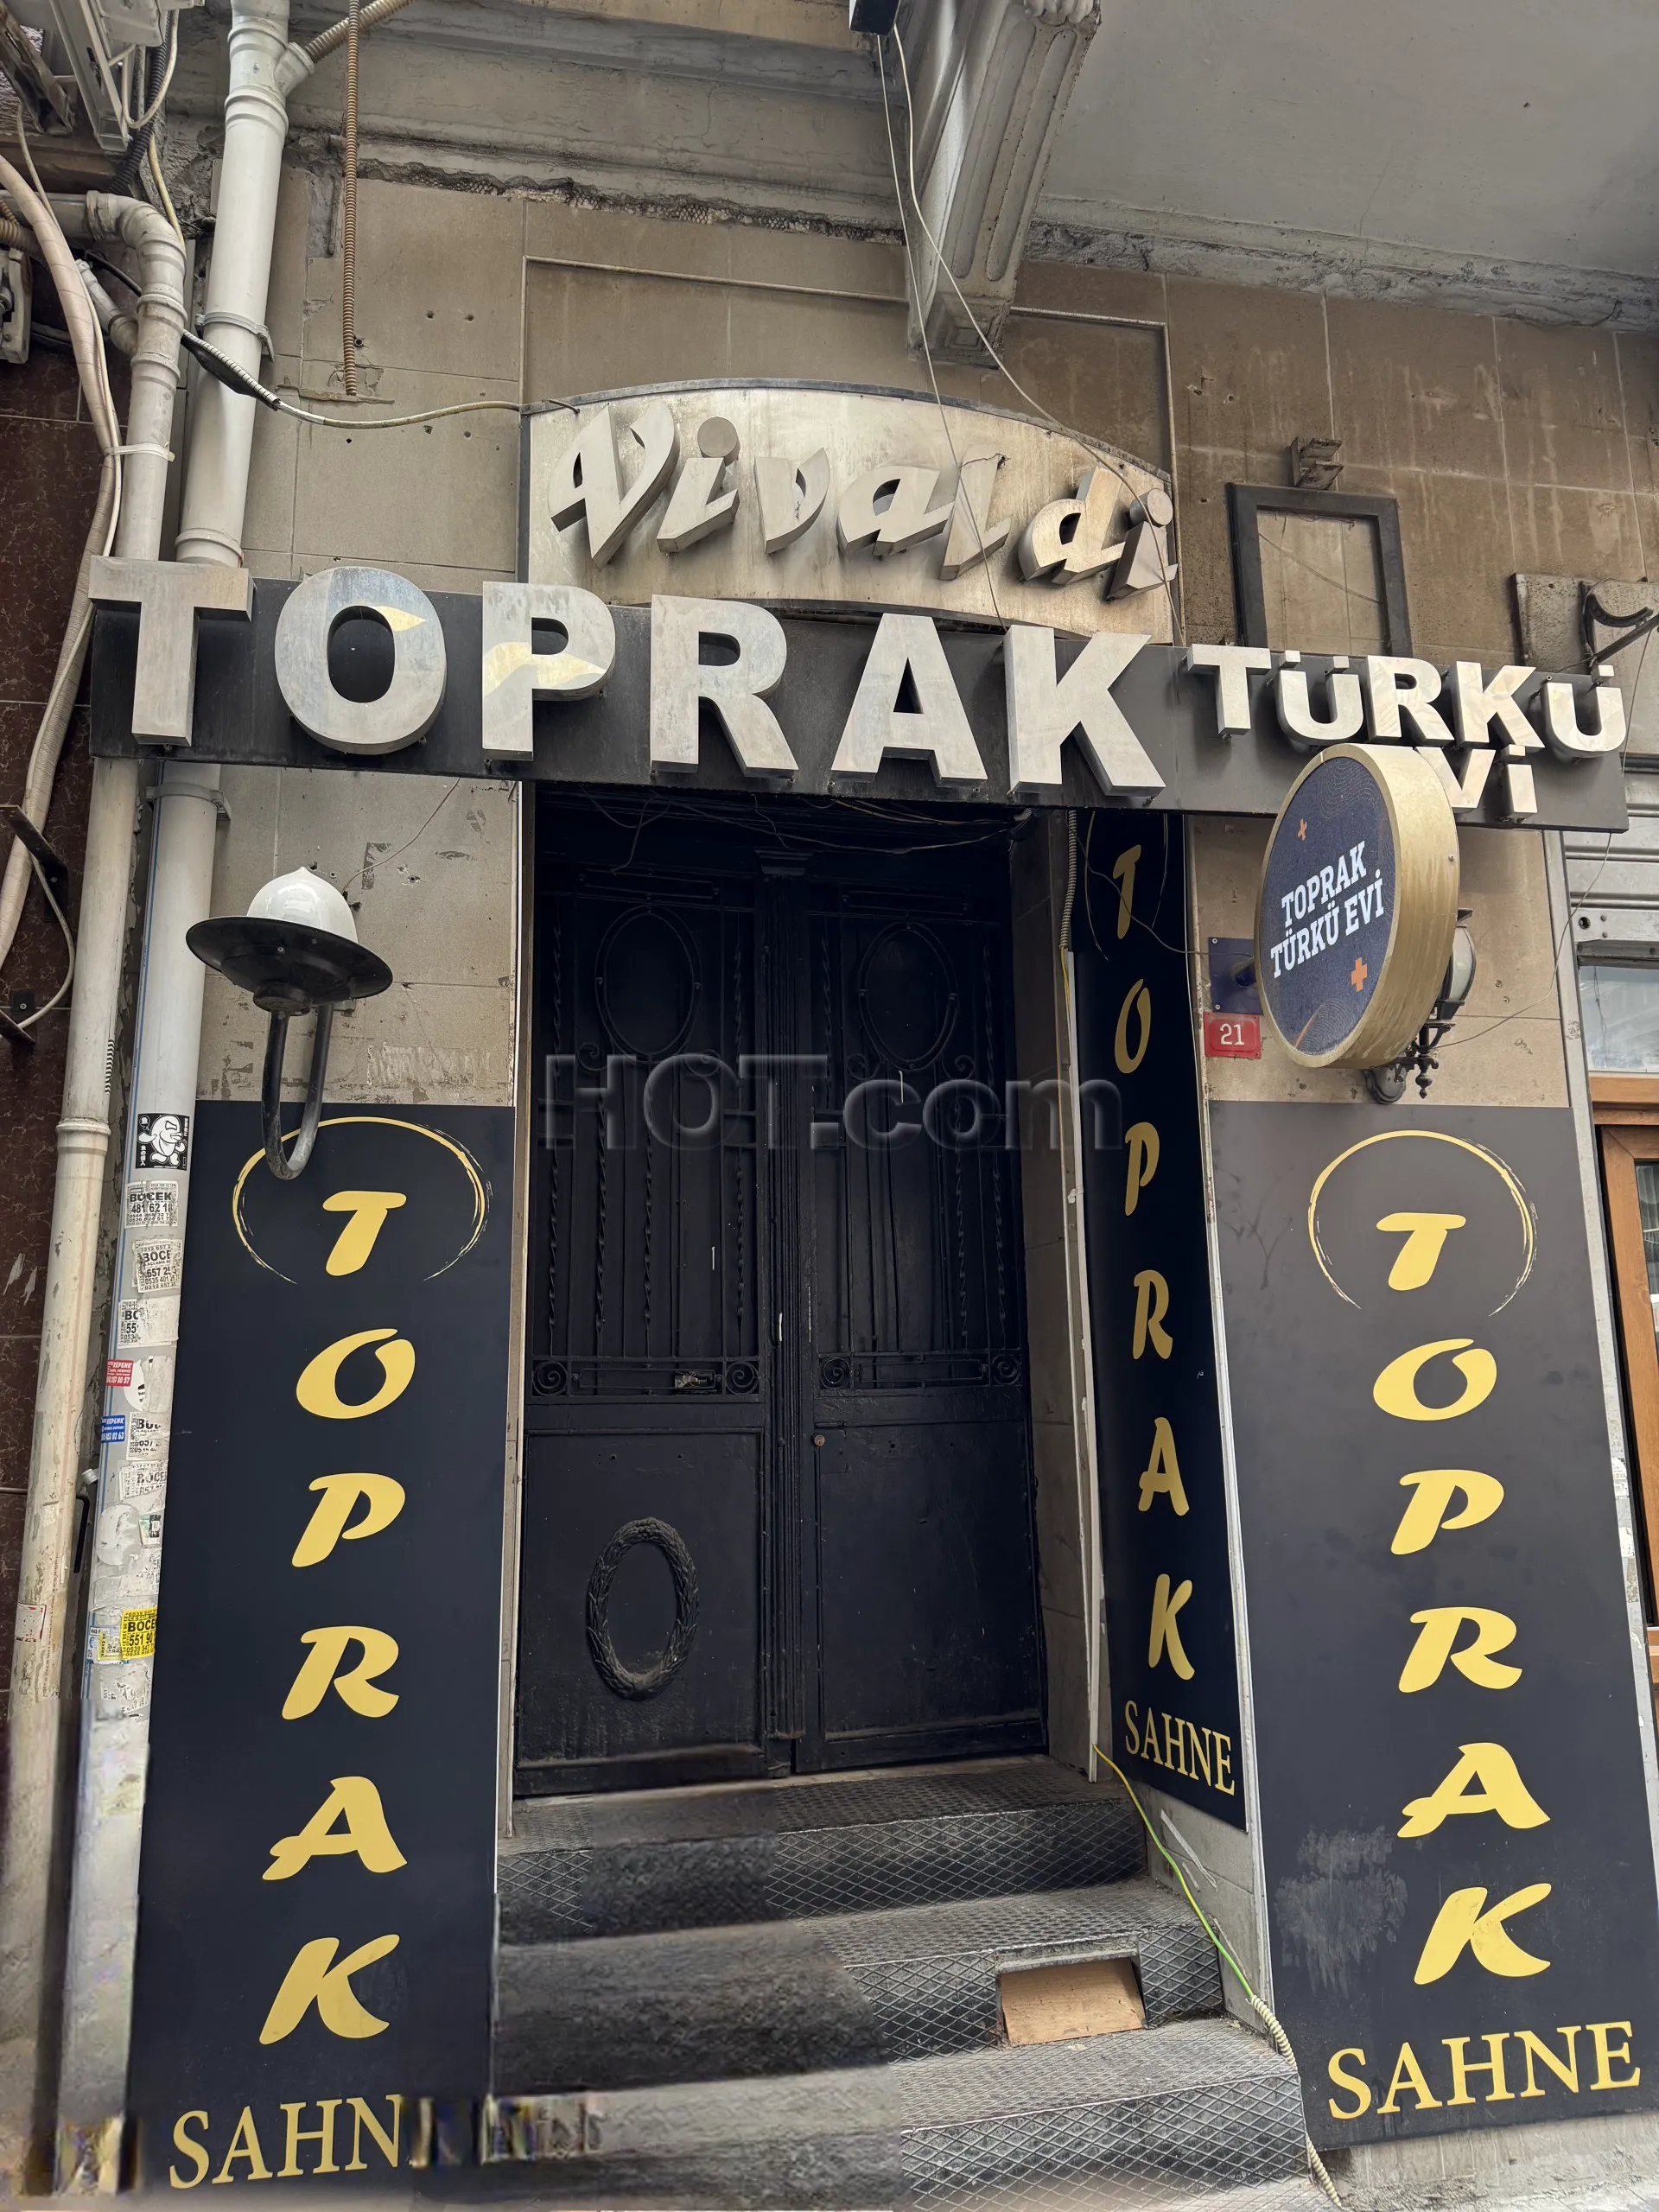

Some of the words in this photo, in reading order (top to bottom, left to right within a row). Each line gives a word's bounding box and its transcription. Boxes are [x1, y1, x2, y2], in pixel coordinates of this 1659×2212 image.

[89, 554, 1166, 797] TOPRAK
[1187, 644, 1626, 759] TÜRKÜ
[1270, 900, 1339, 978] TÜRKÜ
[1344, 868, 1384, 937] EVİ
[1281, 840, 1366, 928] TOPRAK
[1219, 1023, 1245, 1046] 21
[149, 1203, 161, 1212] 62
[147, 1268, 162, 1278] 657
[1112, 844, 1196, 1681] TOPRAK
[126, 1322, 138, 1334] 55
[130, 1634, 144, 1647] 551
[259, 1191, 416, 2045] TOPRAK
[1372, 1211, 1552, 1986] TOPRAK
[1125, 1700, 1236, 1796] SAHNE
[1327, 2021, 1642, 2120] SAHNE
